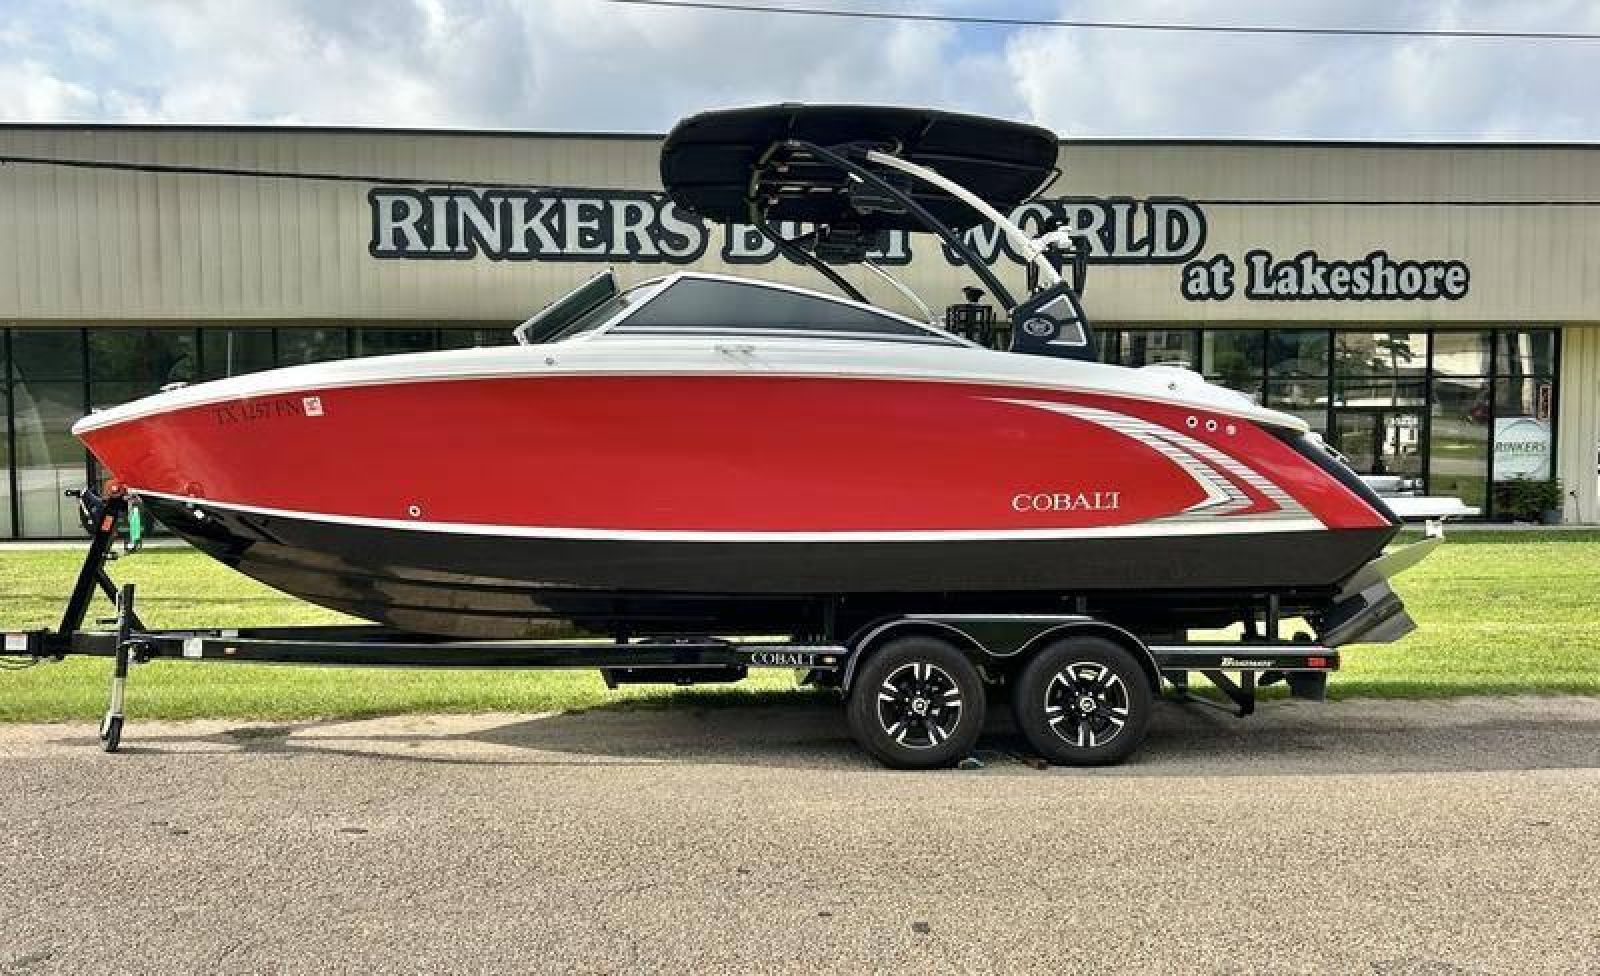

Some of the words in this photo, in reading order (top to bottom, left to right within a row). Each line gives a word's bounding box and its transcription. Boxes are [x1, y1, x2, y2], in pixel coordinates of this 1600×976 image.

[371, 191, 706, 261] RINKERS
[724, 221, 911, 263] BT
[1184, 255, 1233, 298] at
[1247, 252, 1468, 298] Lakeshore
[1011, 491, 1120, 512] COBALT
